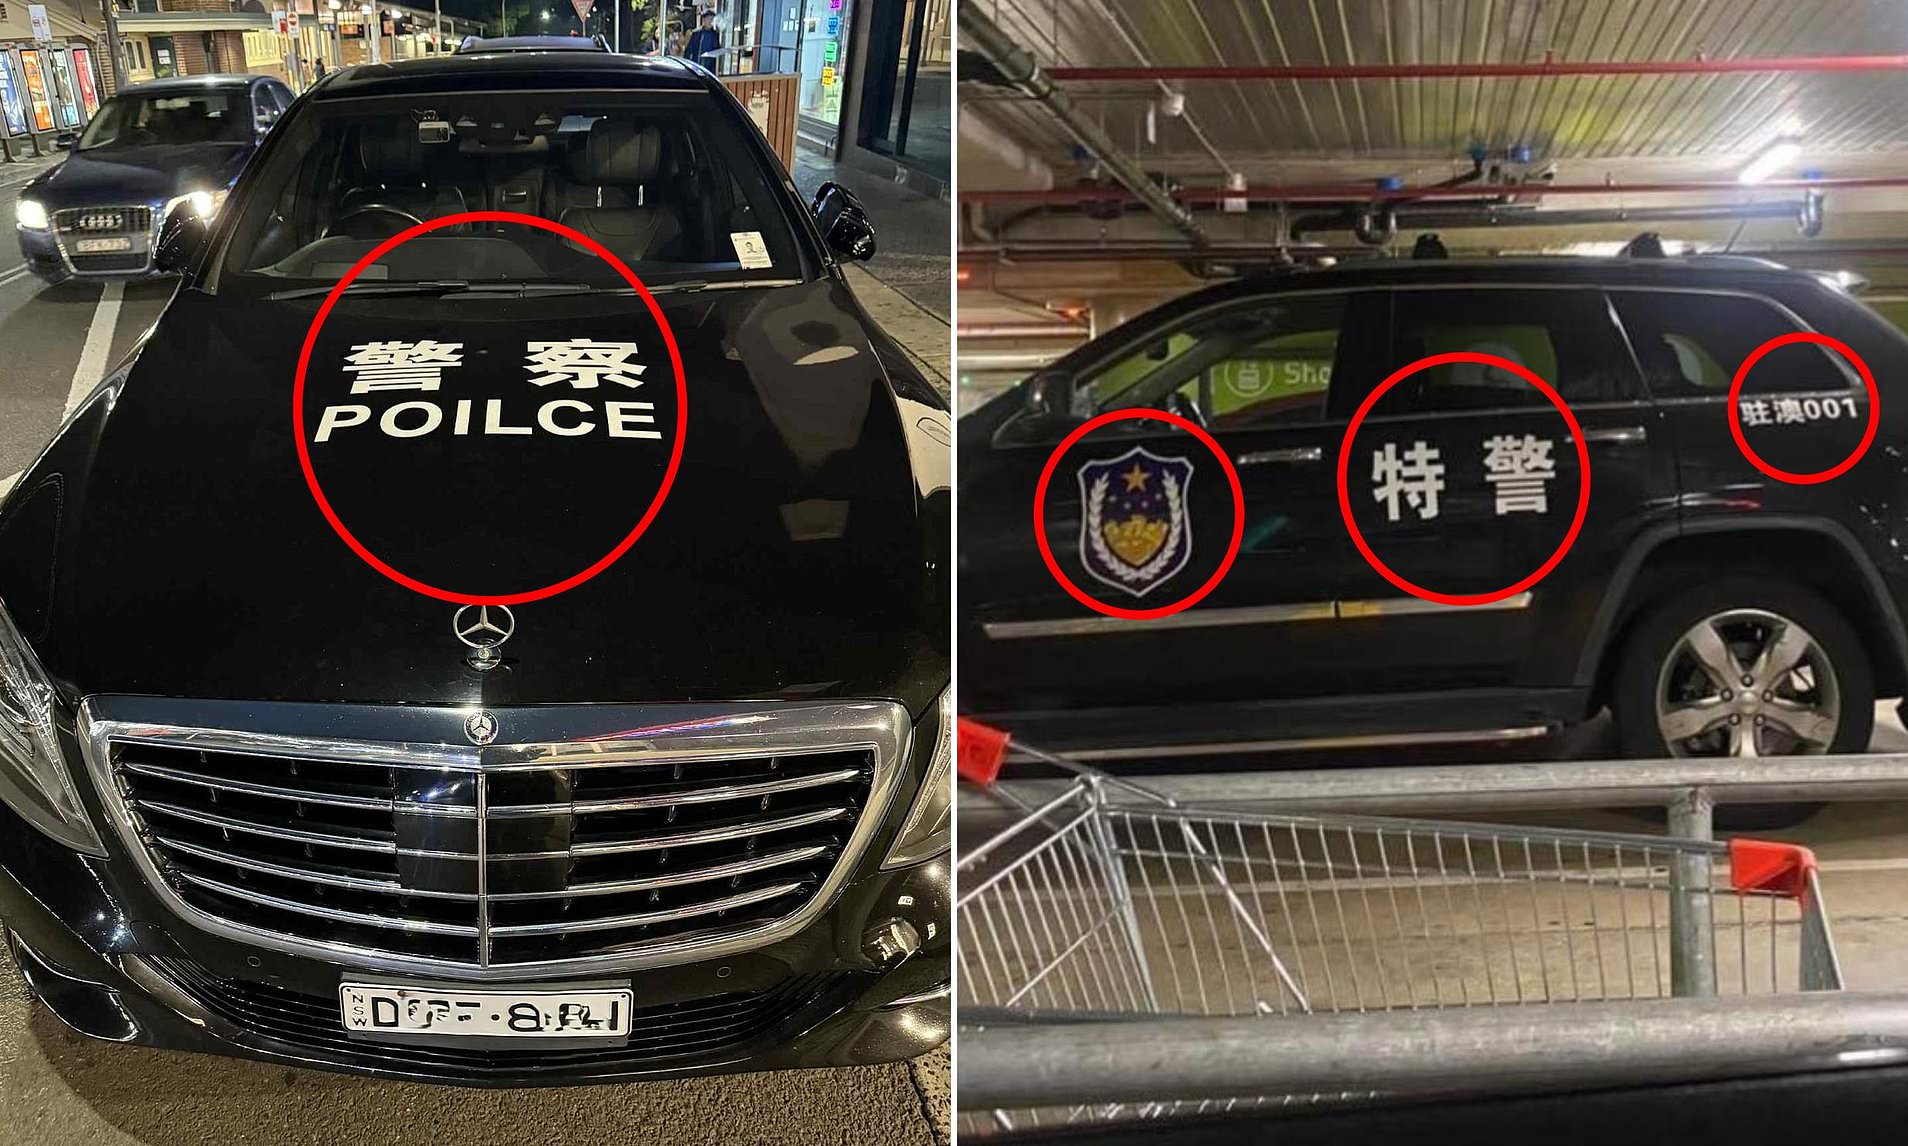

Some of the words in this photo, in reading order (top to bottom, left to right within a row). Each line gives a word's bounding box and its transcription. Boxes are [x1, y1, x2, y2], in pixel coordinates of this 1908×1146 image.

[313, 399, 662, 442] POILCE
[1739, 398, 1858, 426] 驻澳001
[352, 994, 368, 1027] NSW
